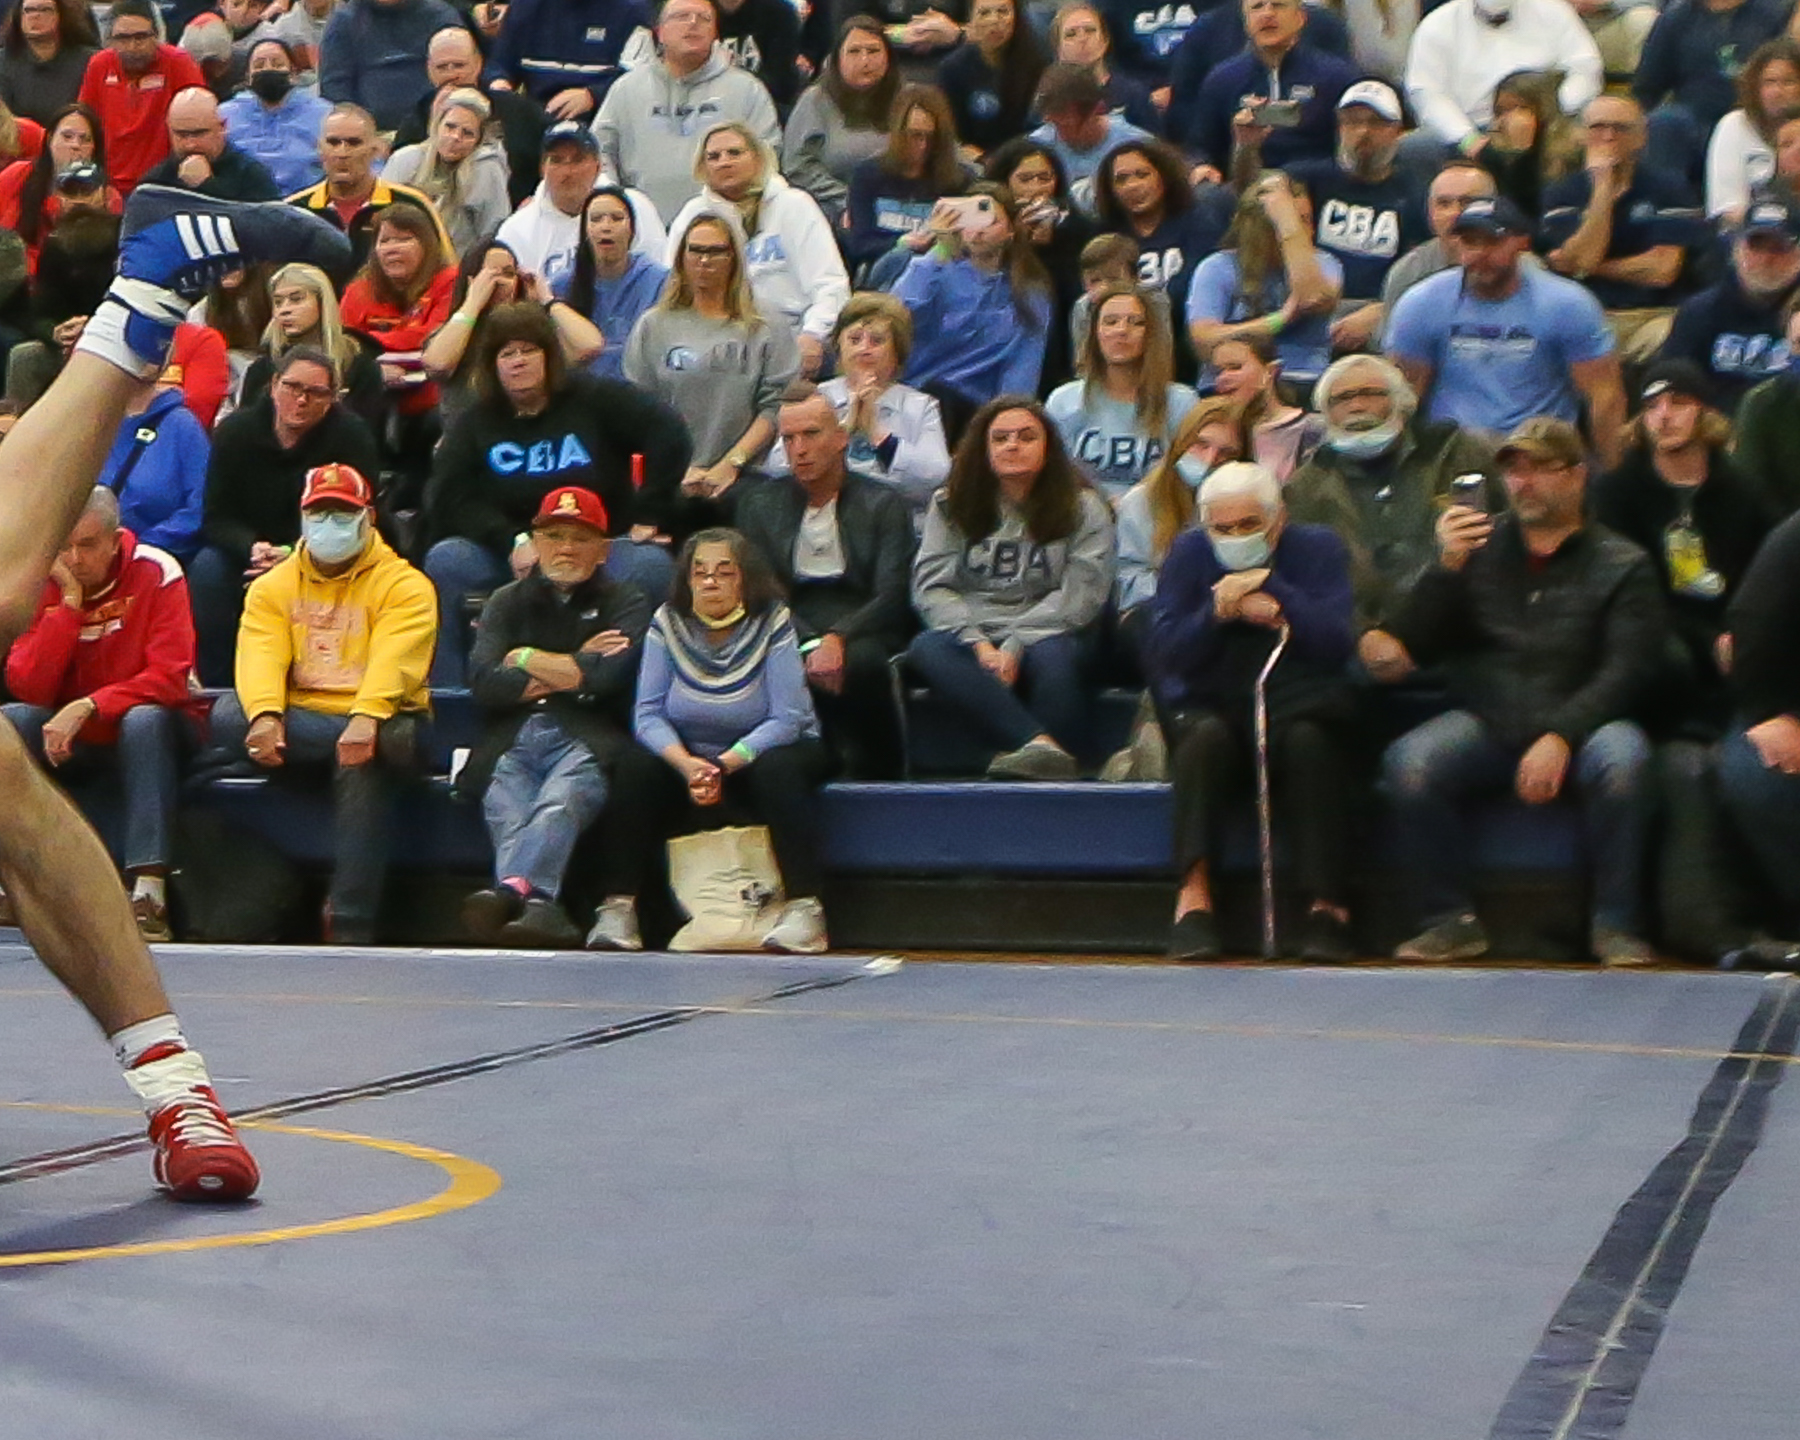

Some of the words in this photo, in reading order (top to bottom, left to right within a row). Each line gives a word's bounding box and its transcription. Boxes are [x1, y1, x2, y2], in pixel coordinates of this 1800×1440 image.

[1317, 198, 1399, 258] CBA
[487, 432, 592, 475] CBA
[1078, 428, 1164, 471] CBA
[964, 539, 1054, 578] CBA
